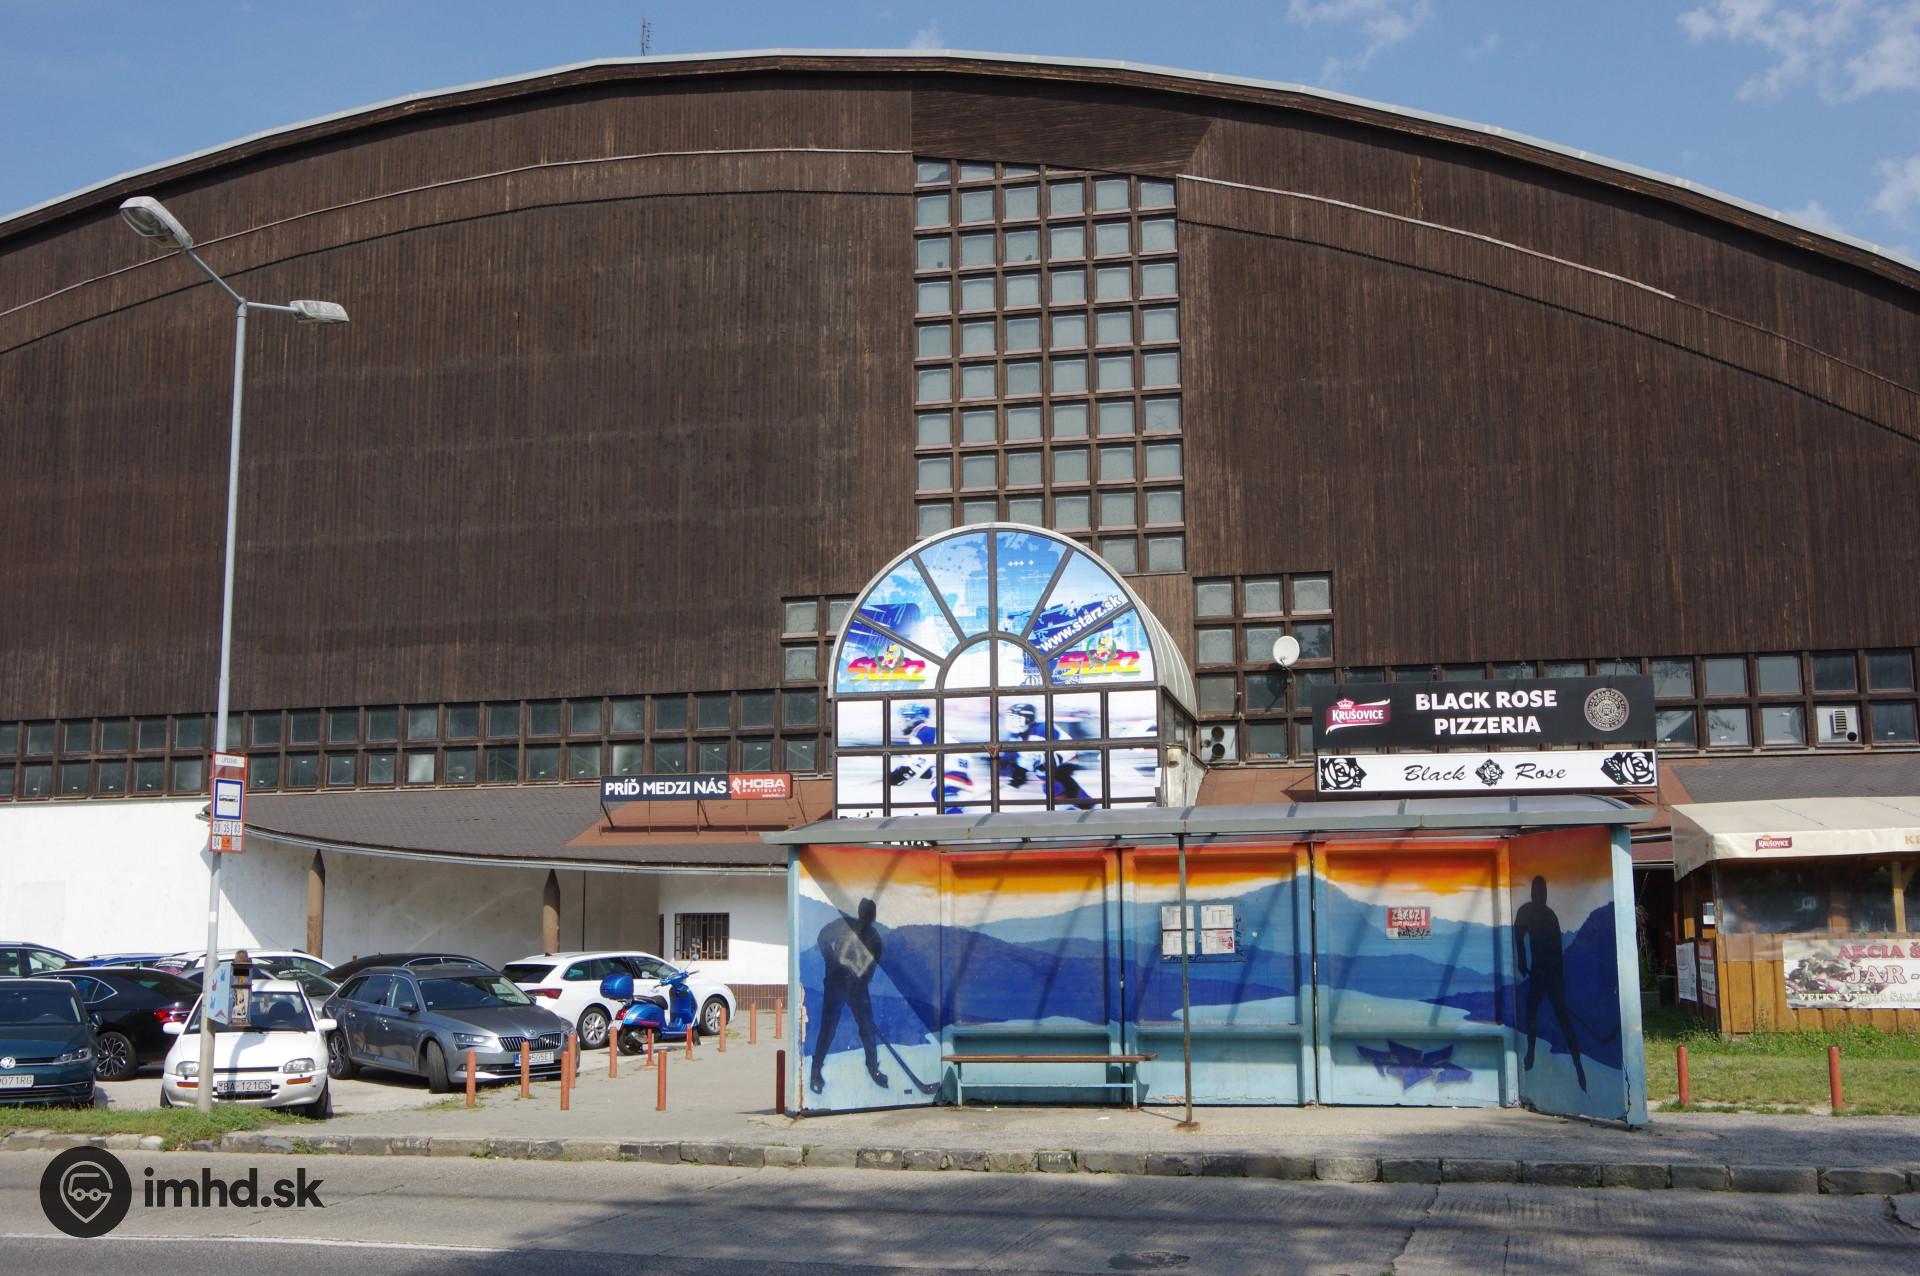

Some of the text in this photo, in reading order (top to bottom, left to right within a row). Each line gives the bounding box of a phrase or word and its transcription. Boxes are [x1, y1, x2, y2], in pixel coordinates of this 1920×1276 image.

[1041, 595, 1120, 651] www.starz.sk
[1415, 689, 1558, 711] BLACK ROSE
[1332, 708, 1384, 723] KRUŠOVICE
[1434, 715, 1541, 735] PIZZERIA
[1404, 763, 1567, 782] Black Rose
[605, 778, 727, 796] PRÍĎ MEDZI NÁS
[742, 778, 786, 789] HOBA
[1838, 945, 1905, 959] AKCIA
[1846, 965, 1907, 984] JAR
